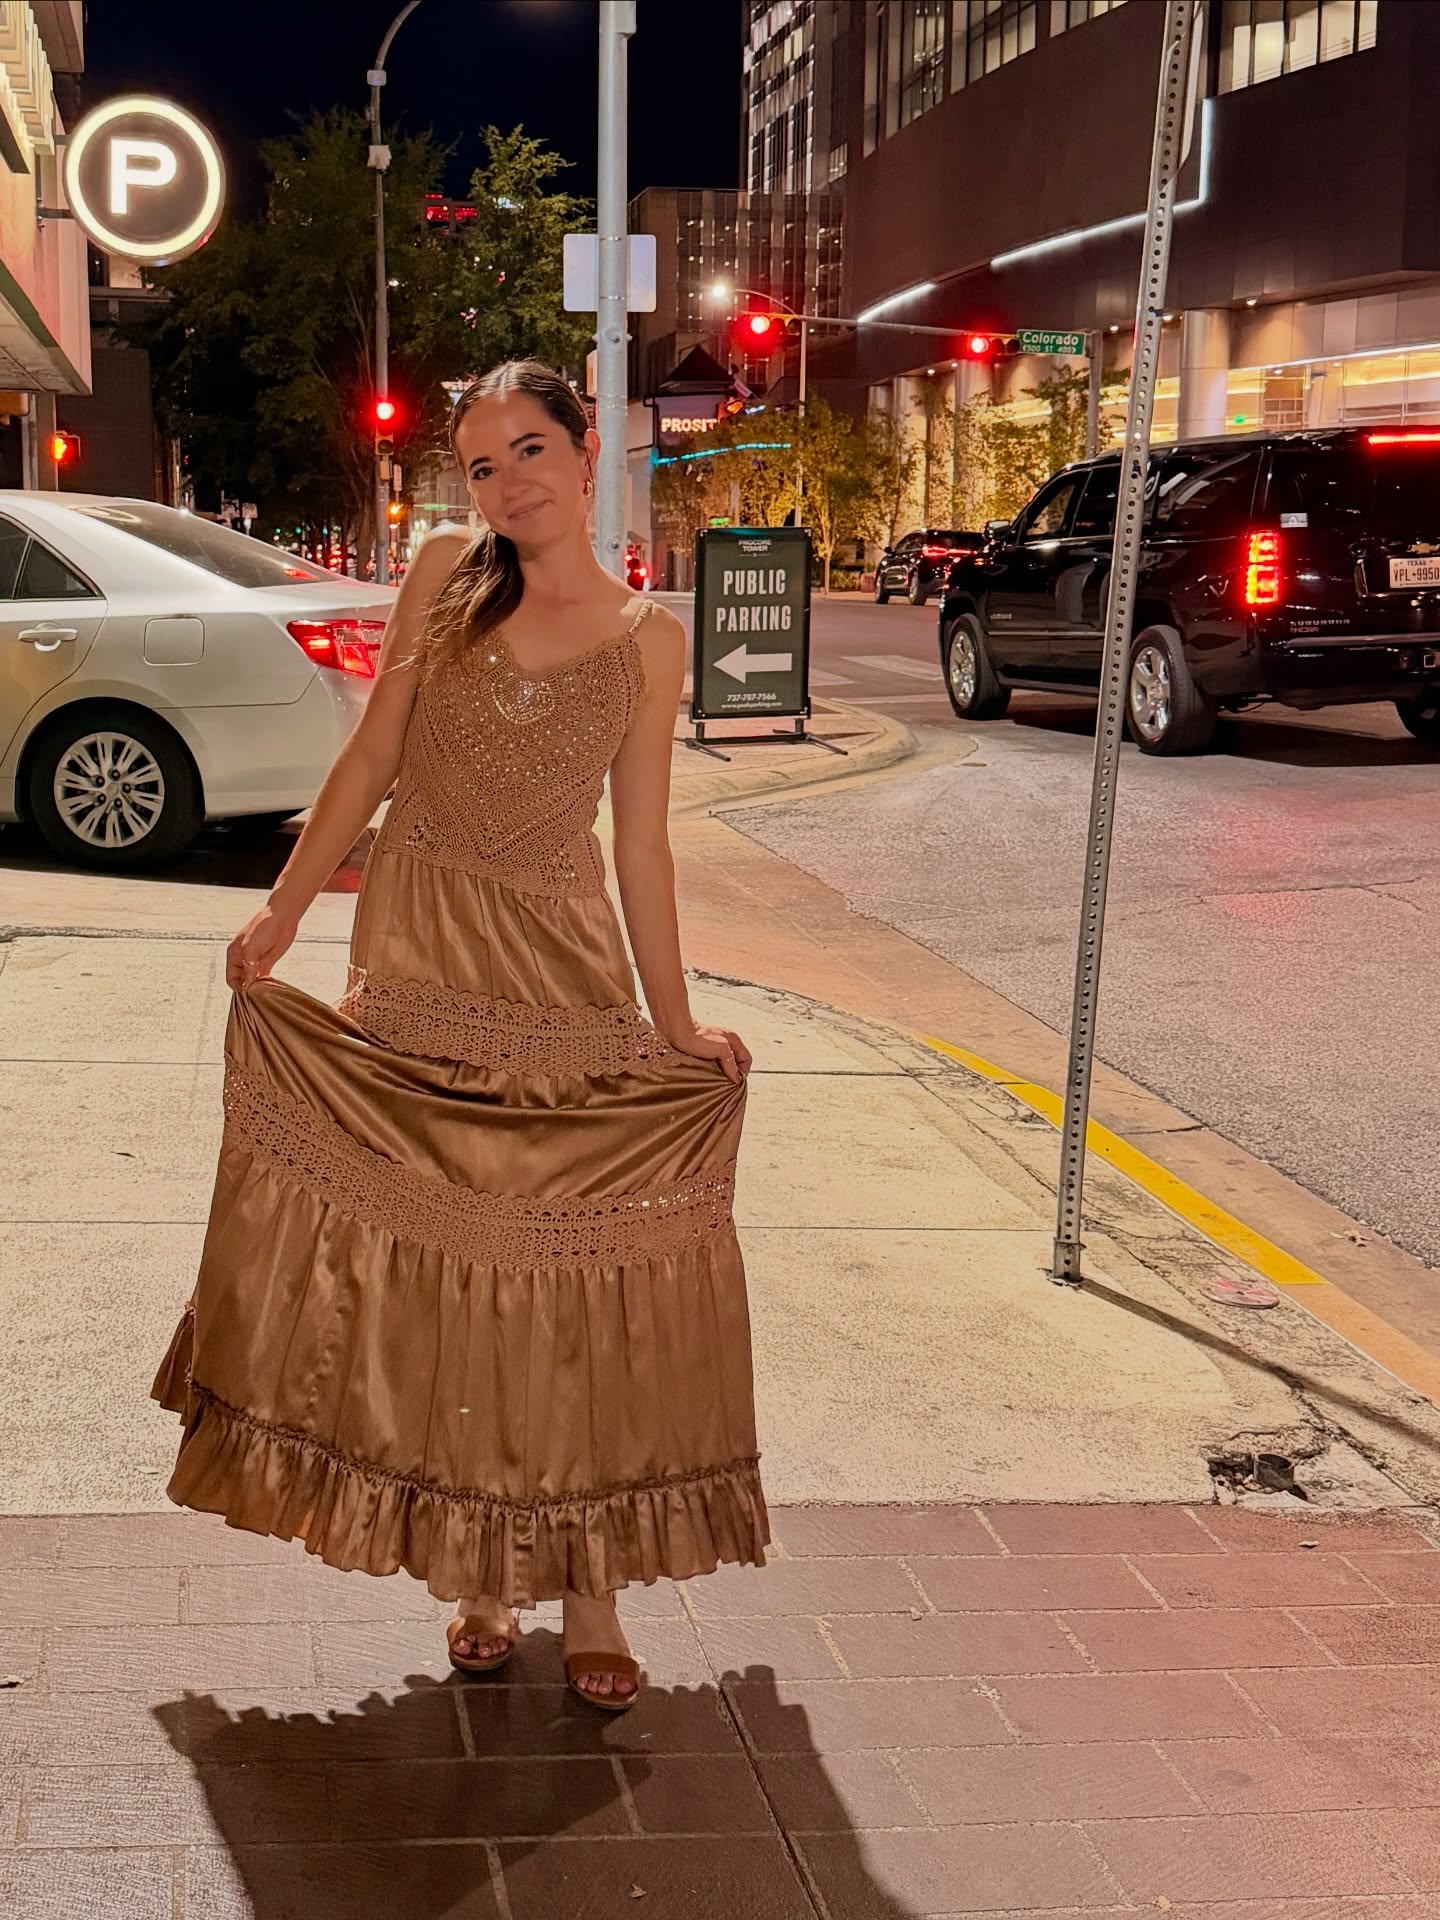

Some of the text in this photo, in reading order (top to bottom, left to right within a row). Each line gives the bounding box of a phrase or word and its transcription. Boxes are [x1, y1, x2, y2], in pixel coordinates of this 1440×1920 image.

[110, 137, 177, 215] P
[1022, 332, 1079, 345] Colorado
[723, 568, 787, 596] PUBLIC
[716, 605, 792, 633] PARKING
